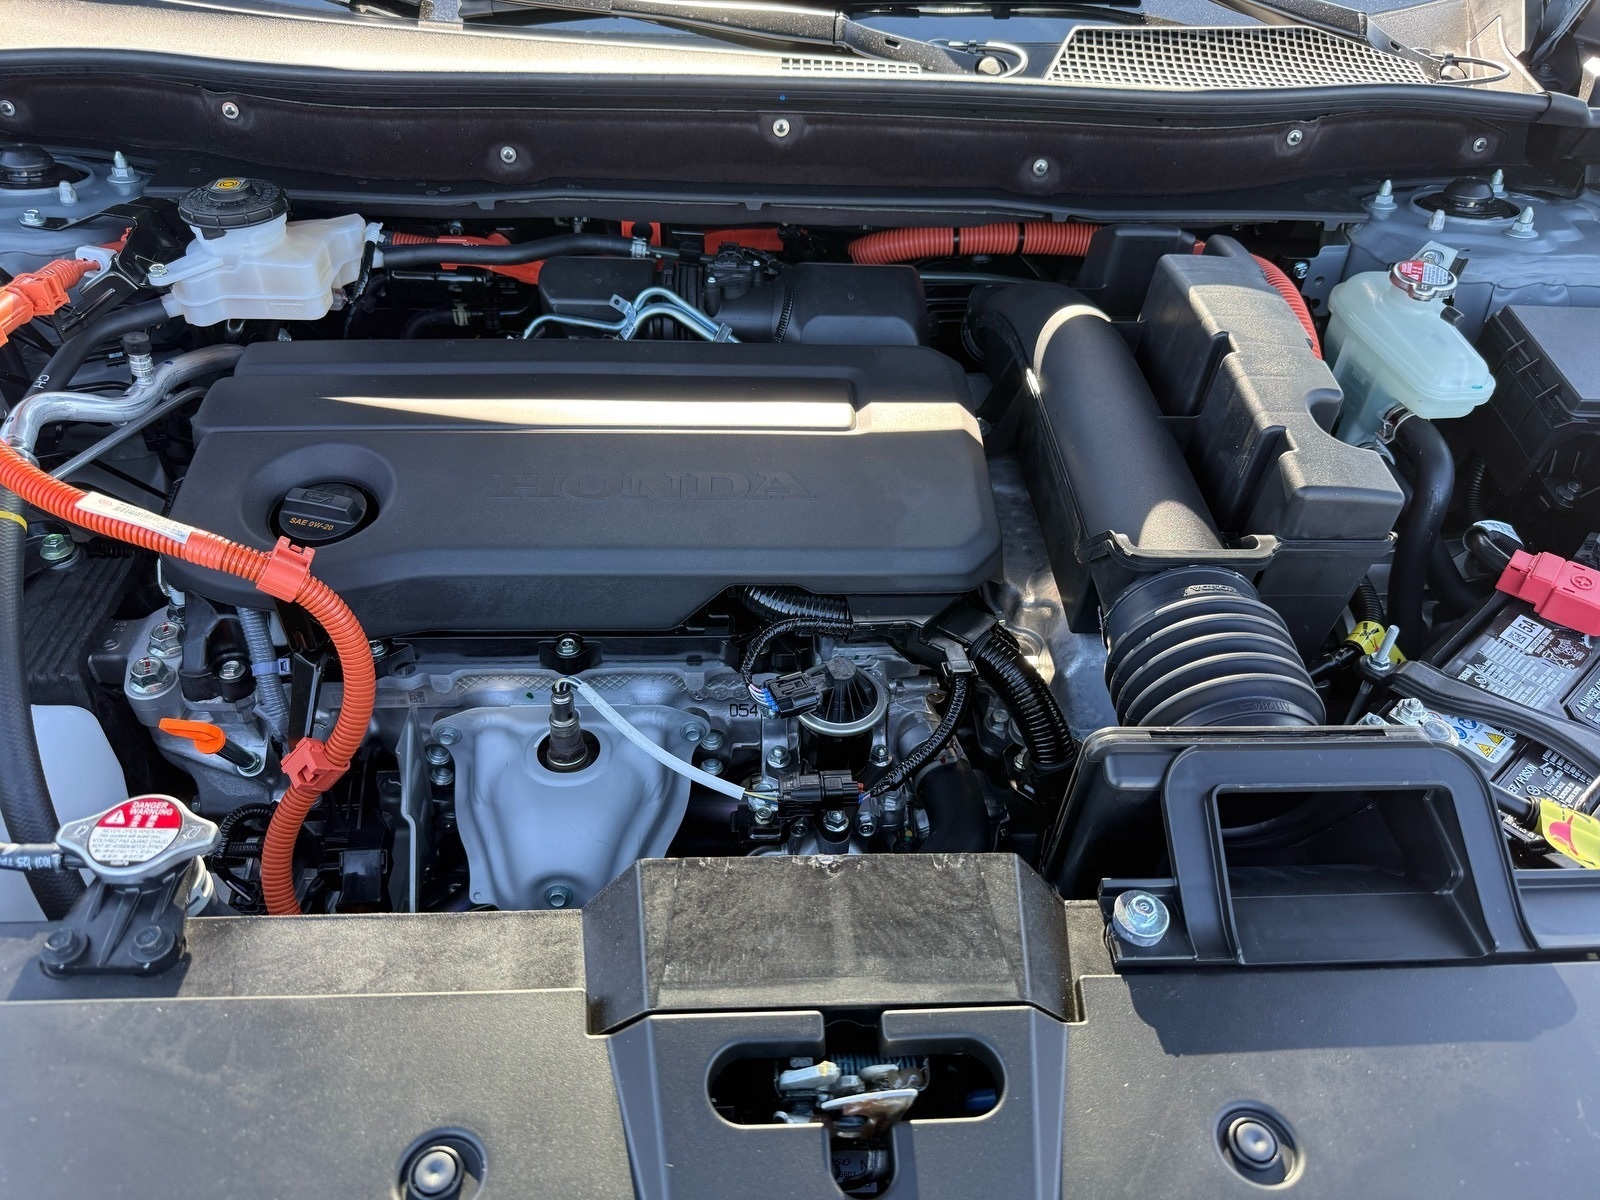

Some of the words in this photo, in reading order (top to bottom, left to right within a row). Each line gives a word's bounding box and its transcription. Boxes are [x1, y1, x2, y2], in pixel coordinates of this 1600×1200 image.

[489, 471, 817, 500] HONDA
[290, 517, 308, 526] SAE
[308, 521, 334, 531] 0W-20
[1518, 619, 1538, 632] 5A
[729, 703, 759, 718] 054
[130, 808, 174, 816] WARNUNG
